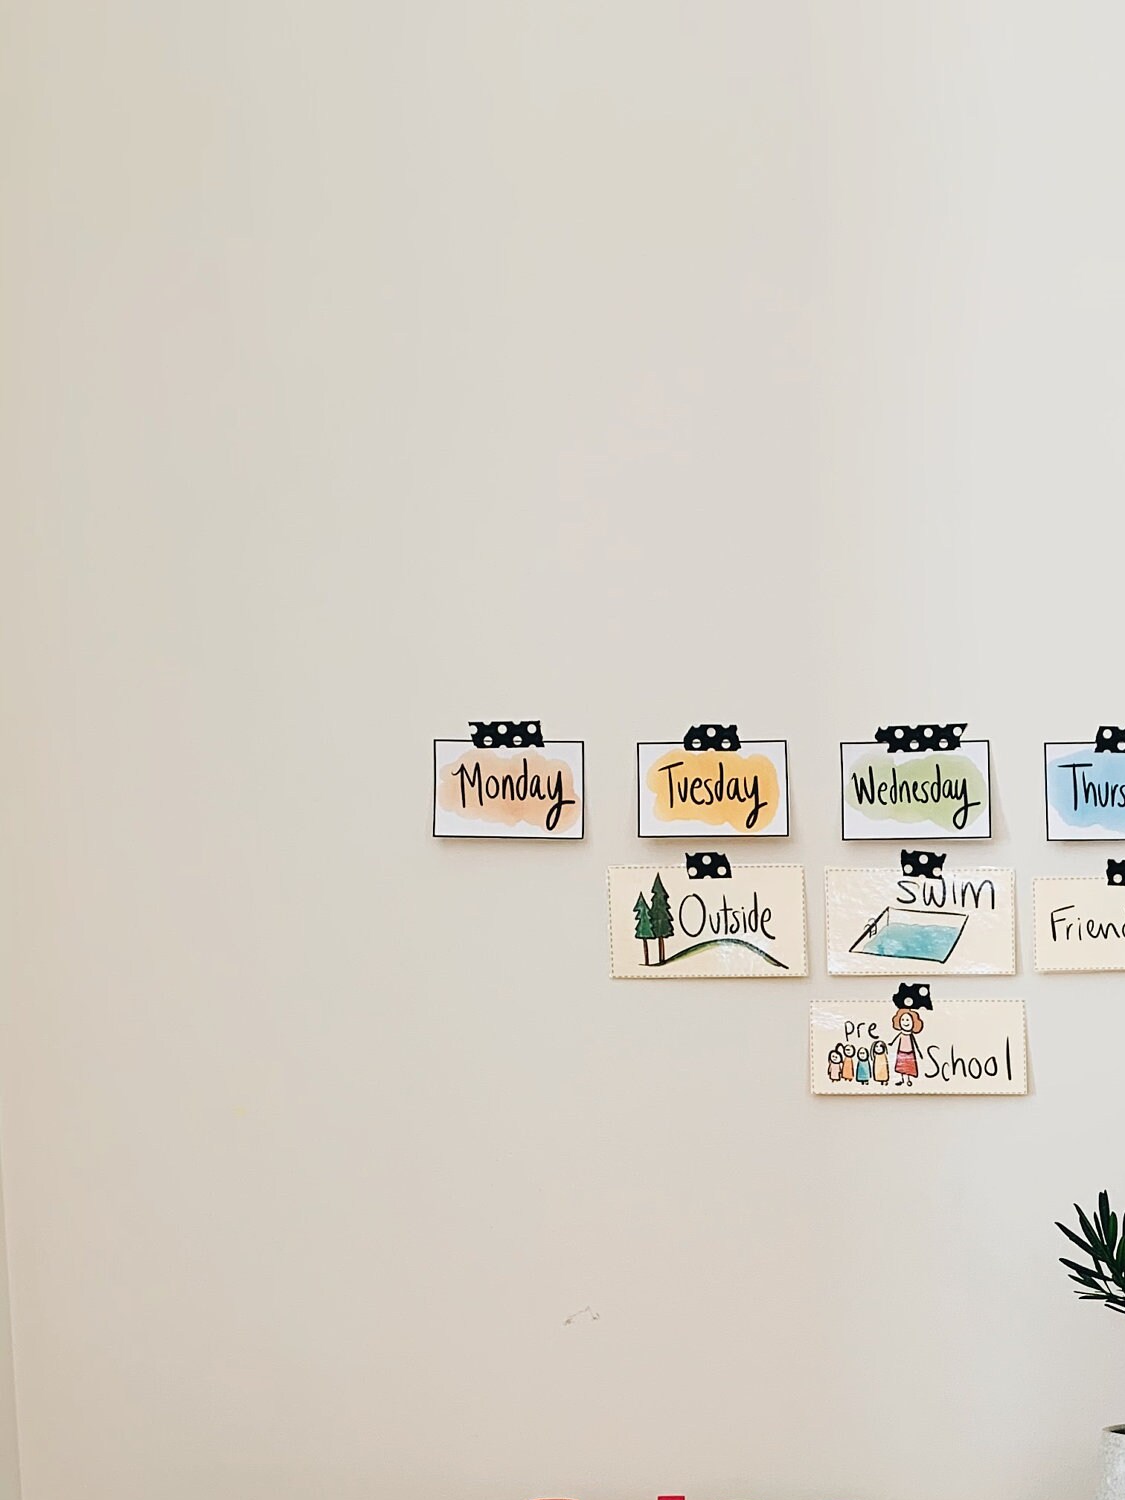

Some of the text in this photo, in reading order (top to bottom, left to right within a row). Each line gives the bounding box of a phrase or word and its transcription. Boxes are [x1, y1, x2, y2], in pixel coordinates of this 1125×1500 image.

[452, 758, 576, 831] Monday
[658, 761, 768, 829] Tuesday
[851, 763, 981, 830] Wednesday
[678, 891, 776, 941] Outside
[844, 1020, 880, 1042] pre
[924, 1037, 1012, 1082] School
